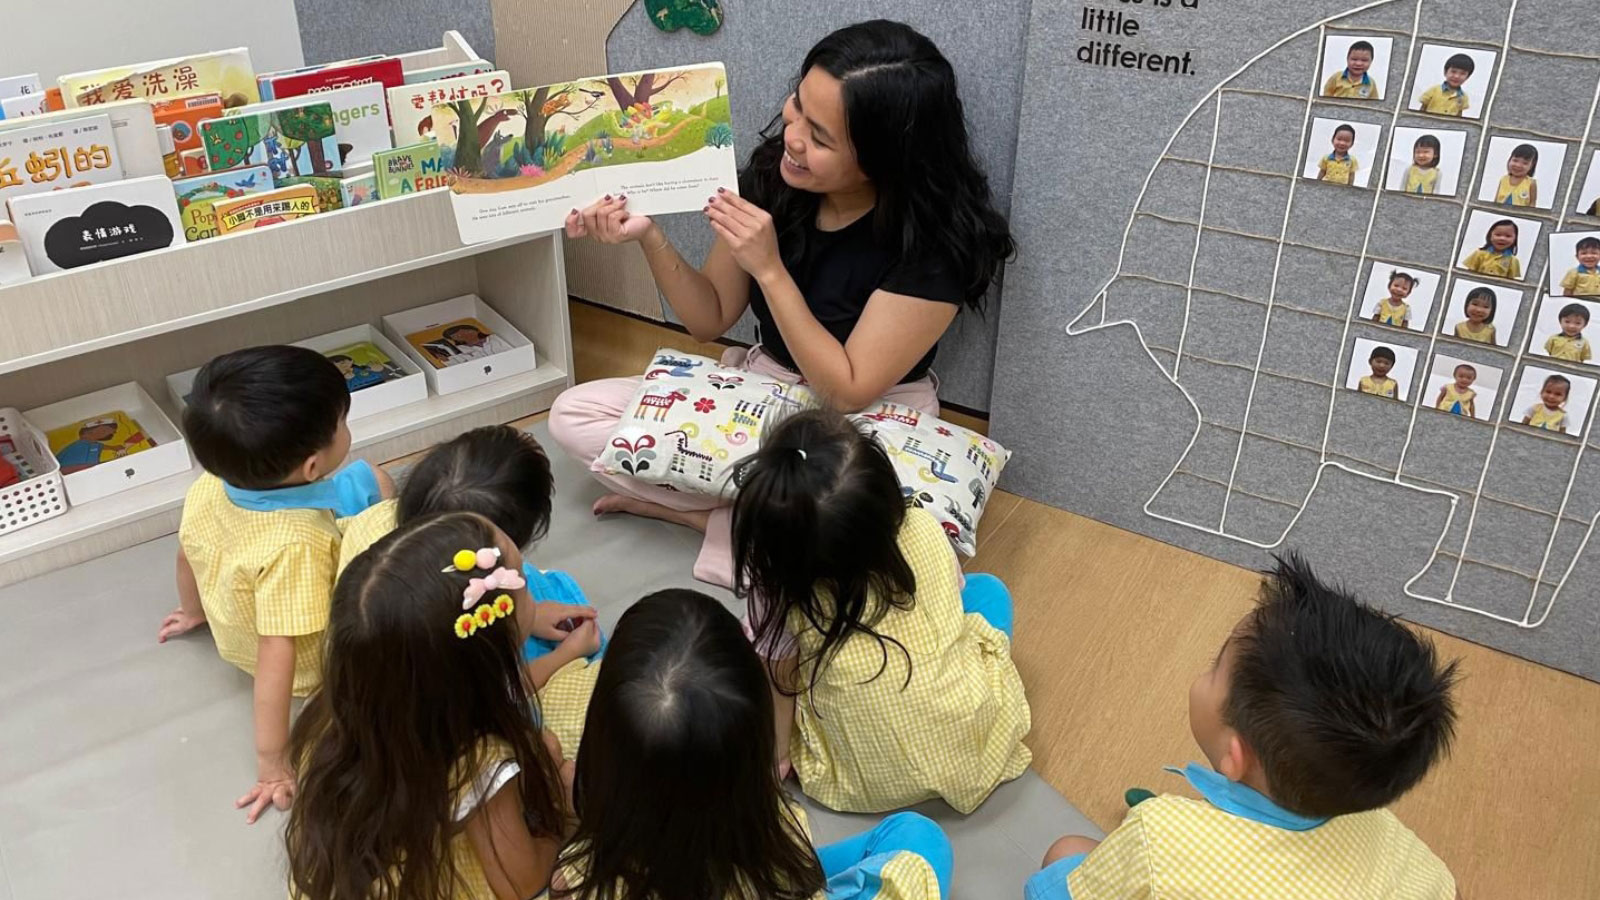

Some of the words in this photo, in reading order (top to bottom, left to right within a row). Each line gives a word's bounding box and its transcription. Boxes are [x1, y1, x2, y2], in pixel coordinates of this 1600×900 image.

[1082, 7, 1140, 37] little
[1077, 41, 1195, 75] different.
[80, 65, 199, 106] 我爱洗澡
[401, 178, 413, 194] A
[82, 223, 137, 242] 表情游戏
